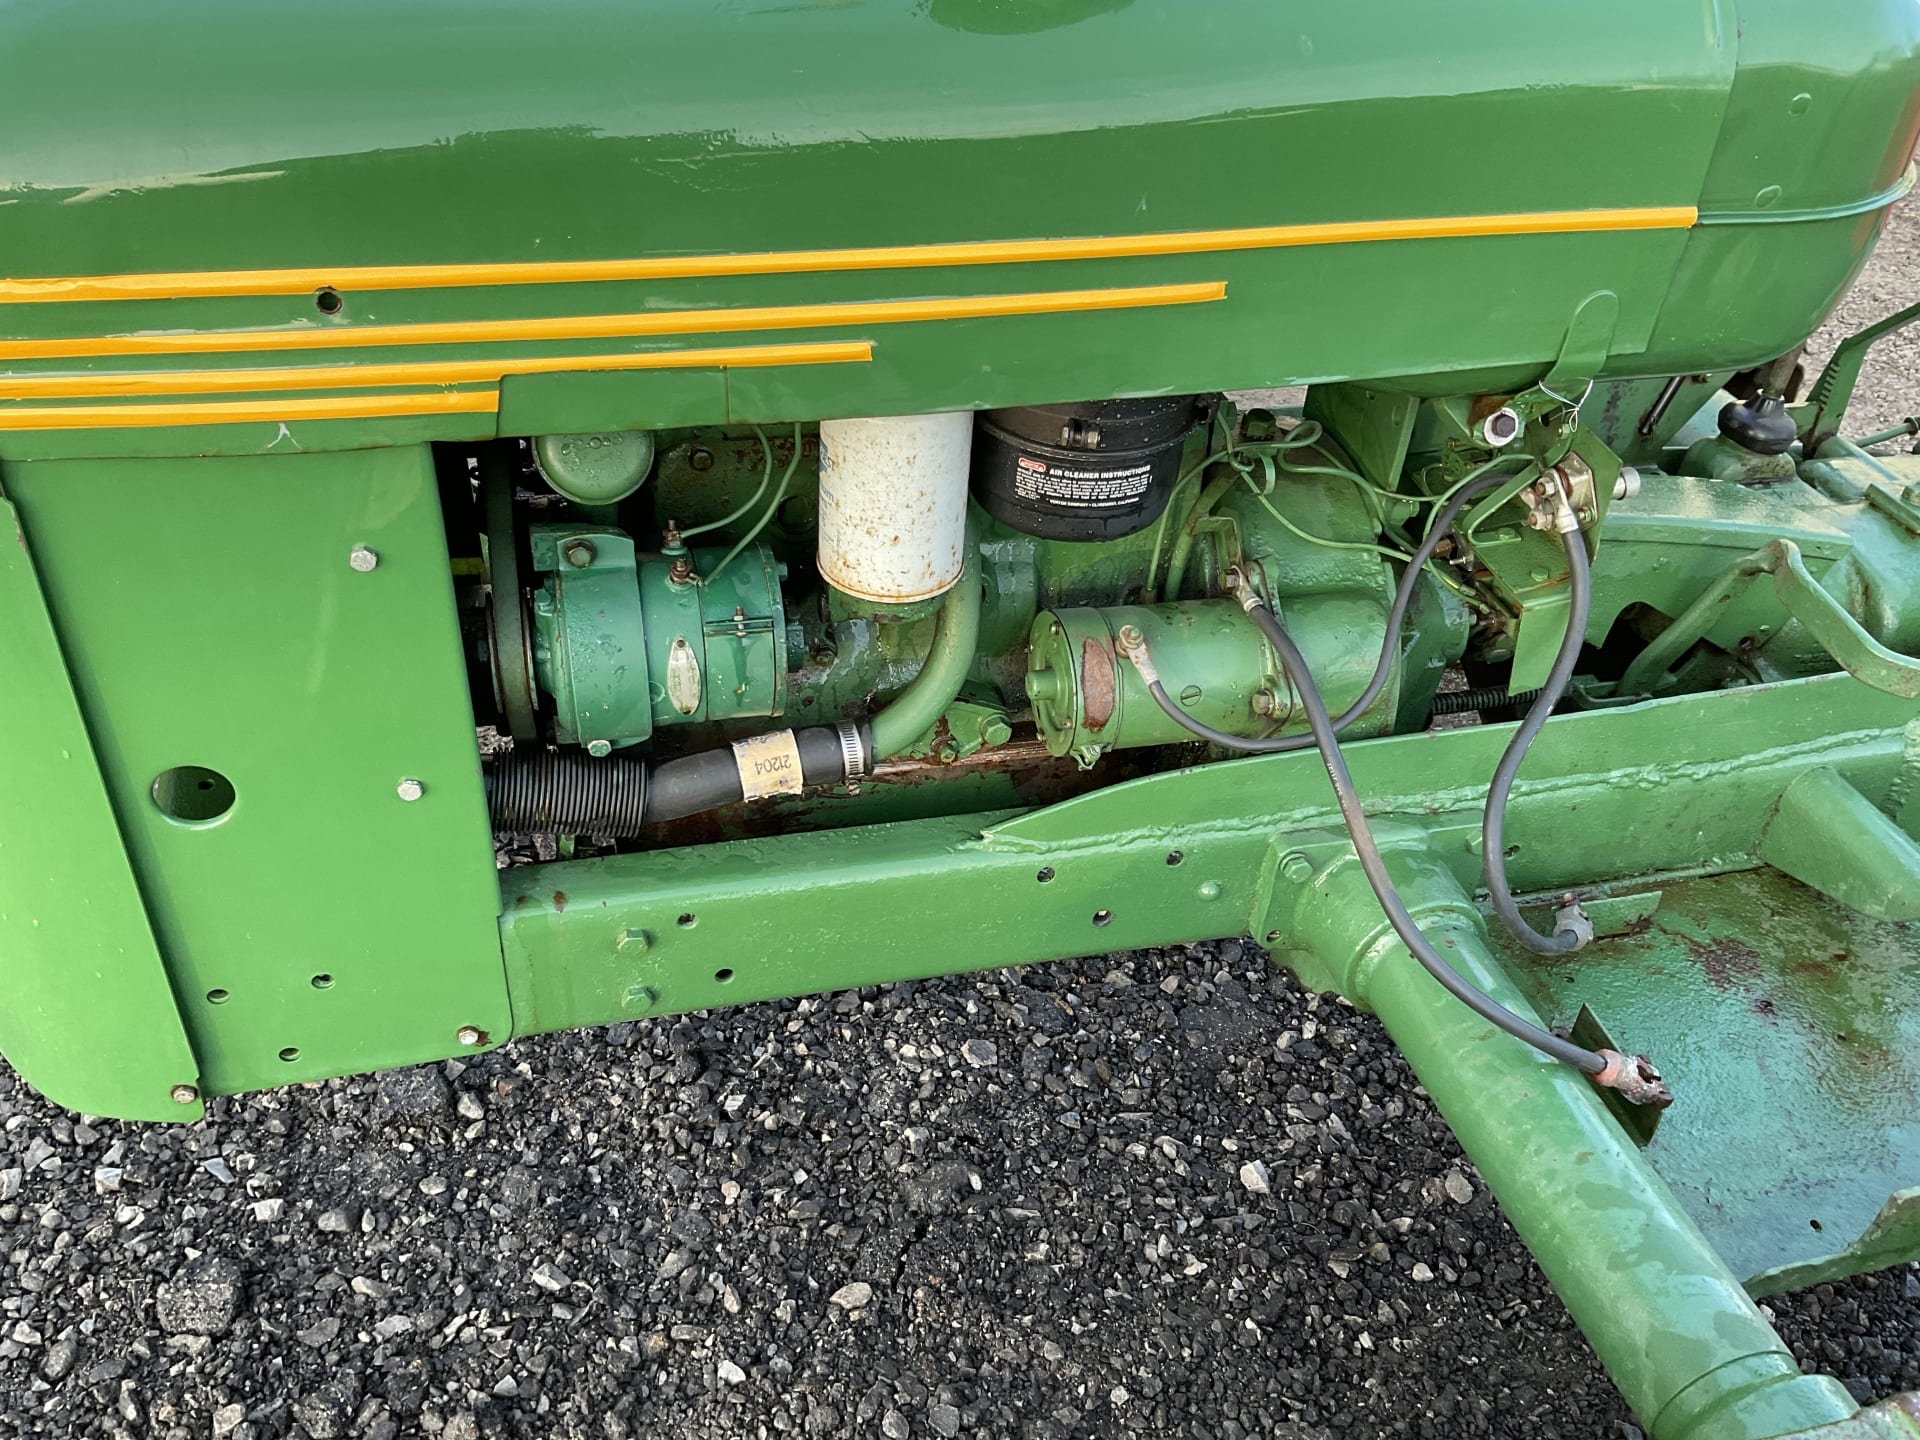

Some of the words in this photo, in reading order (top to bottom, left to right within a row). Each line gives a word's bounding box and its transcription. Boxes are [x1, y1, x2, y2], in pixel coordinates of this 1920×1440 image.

[1050, 468, 1063, 477] AIR
[1064, 470, 1099, 479] CLEANER
[1101, 465, 1151, 479] INSTRUCTIONS
[754, 754, 792, 775] 21204
